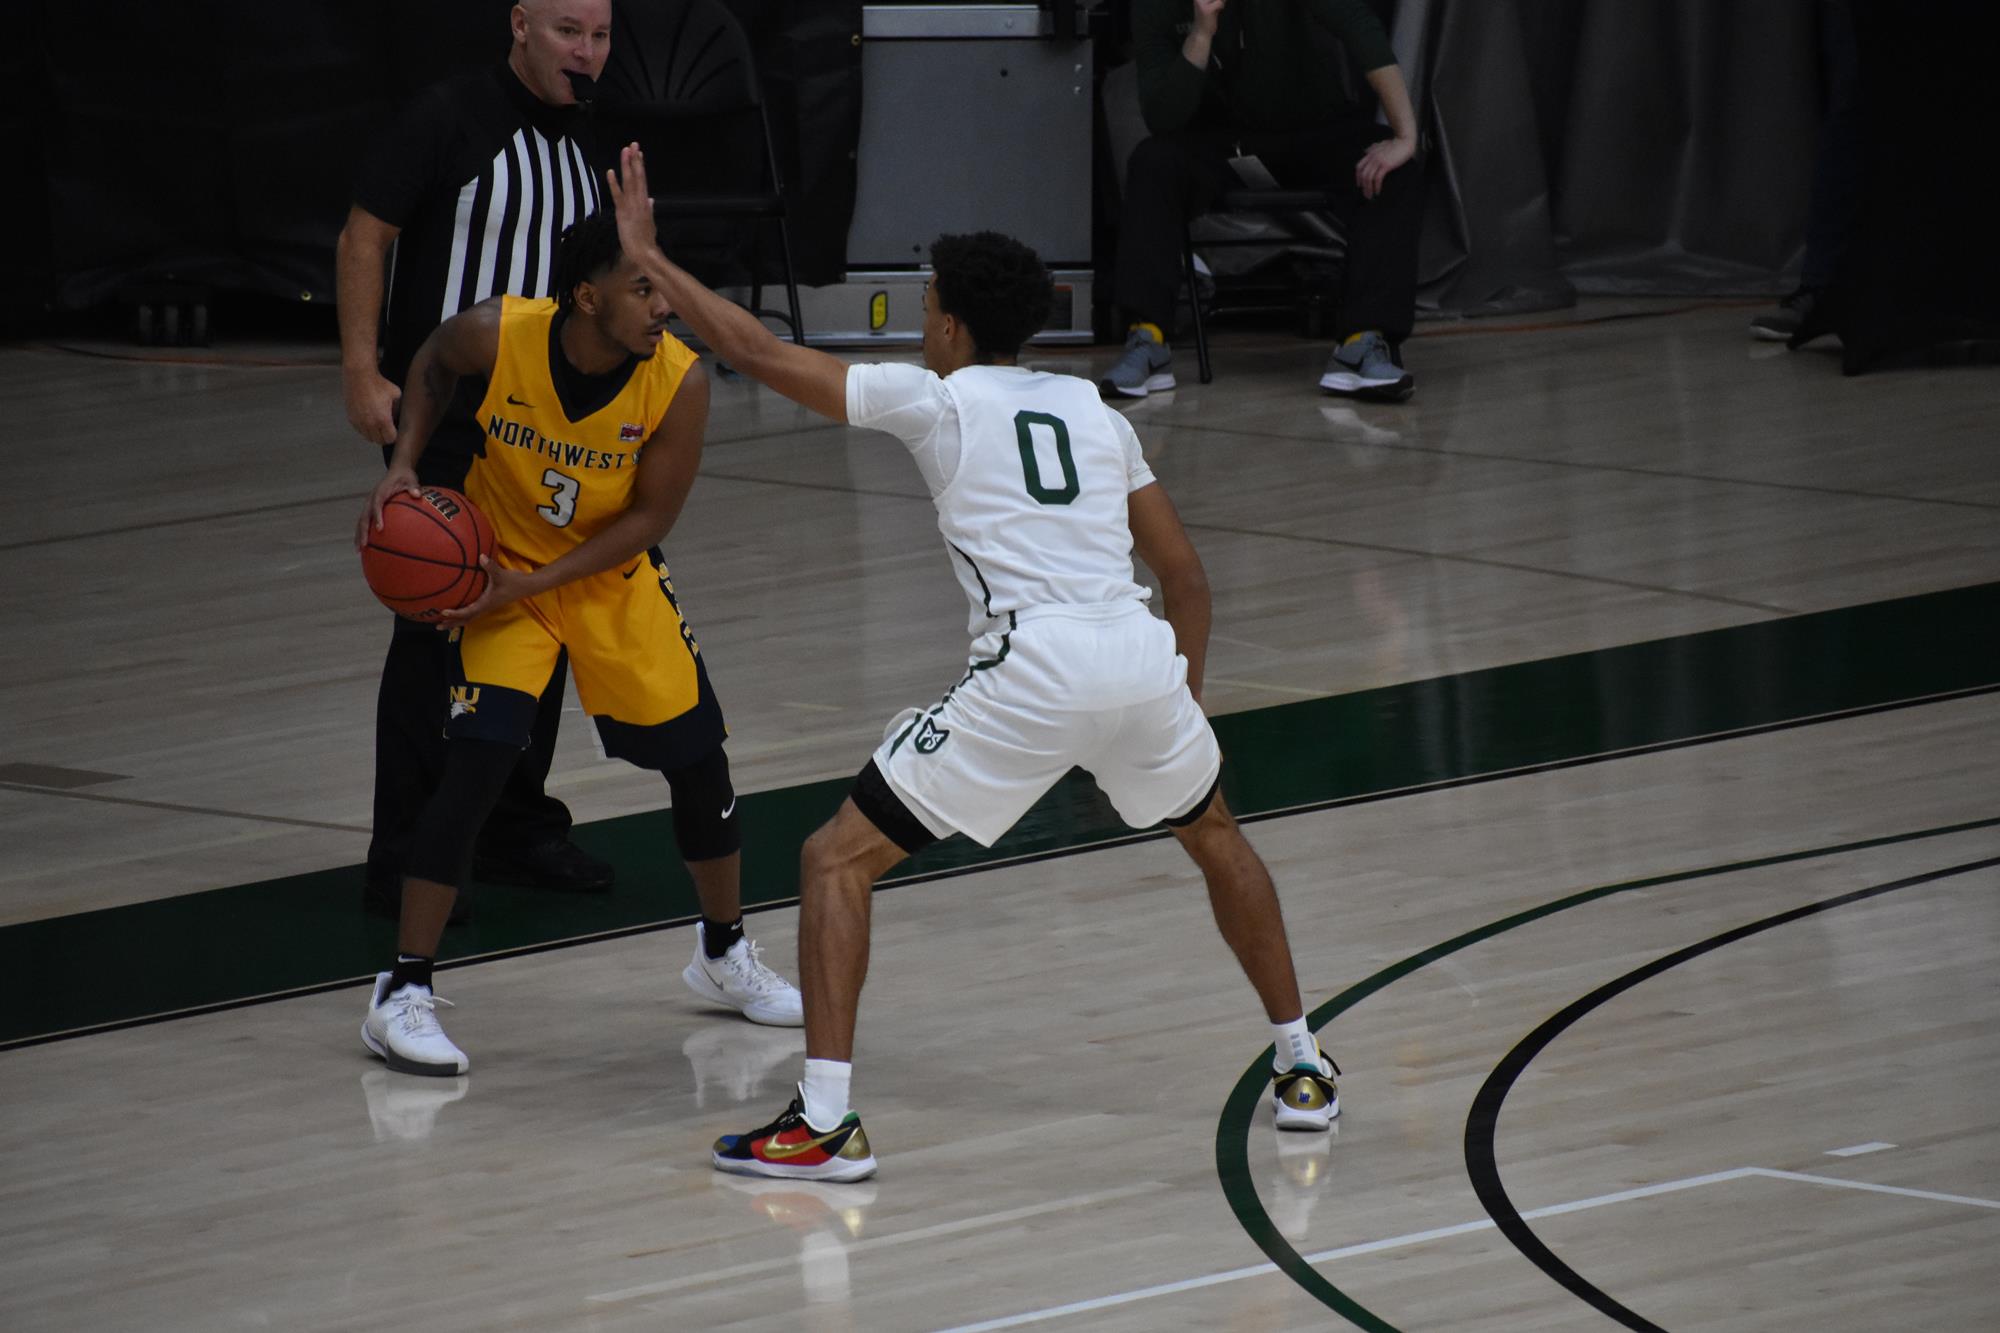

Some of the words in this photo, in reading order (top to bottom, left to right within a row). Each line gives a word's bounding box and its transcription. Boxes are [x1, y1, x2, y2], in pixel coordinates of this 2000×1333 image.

[488, 414, 627, 469] NORTHWEST
[1014, 409, 1081, 505] 0
[536, 467, 580, 528] 3
[449, 685, 481, 705] NU
